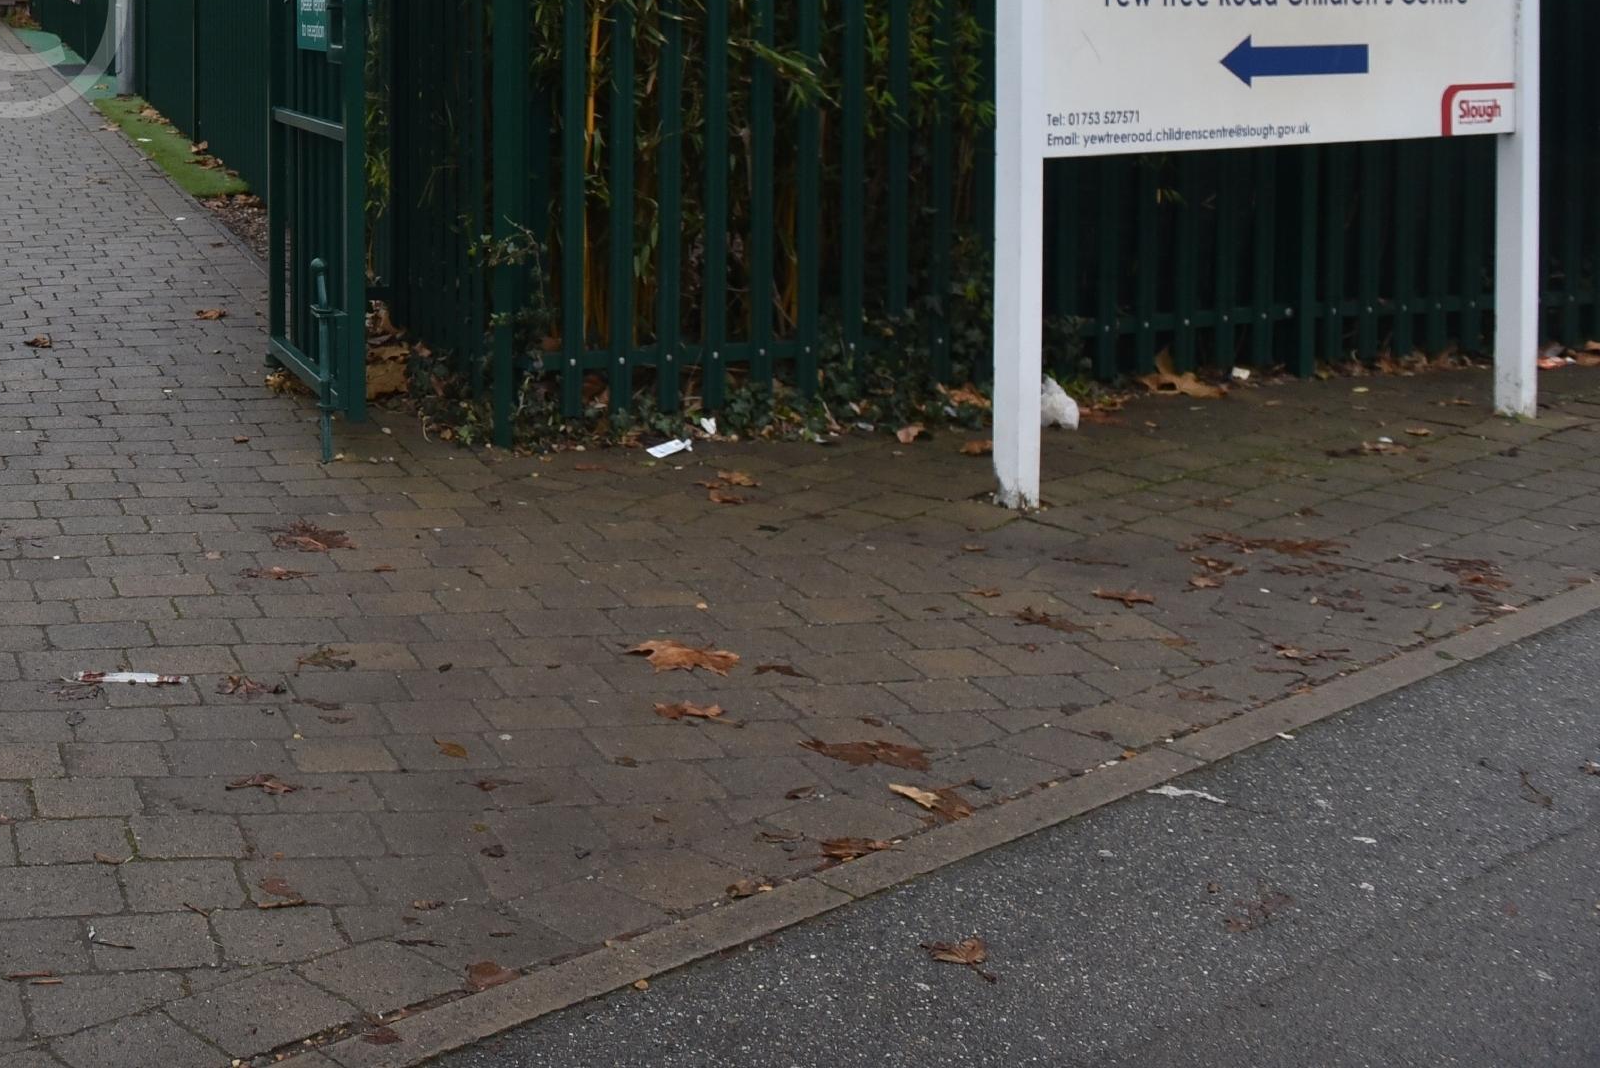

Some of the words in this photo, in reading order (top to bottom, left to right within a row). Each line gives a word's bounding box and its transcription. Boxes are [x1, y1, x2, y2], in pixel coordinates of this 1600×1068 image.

[1046, 113, 1066, 126] Tel:
[1068, 112, 1100, 126] 01753
[1103, 110, 1141, 125] 527571
[1458, 99, 1502, 123] Slough
[1047, 133, 1081, 147] Email:
[1083, 122, 1311, 148] yewtreeroad.childrenscentre@slough.gov.uk
